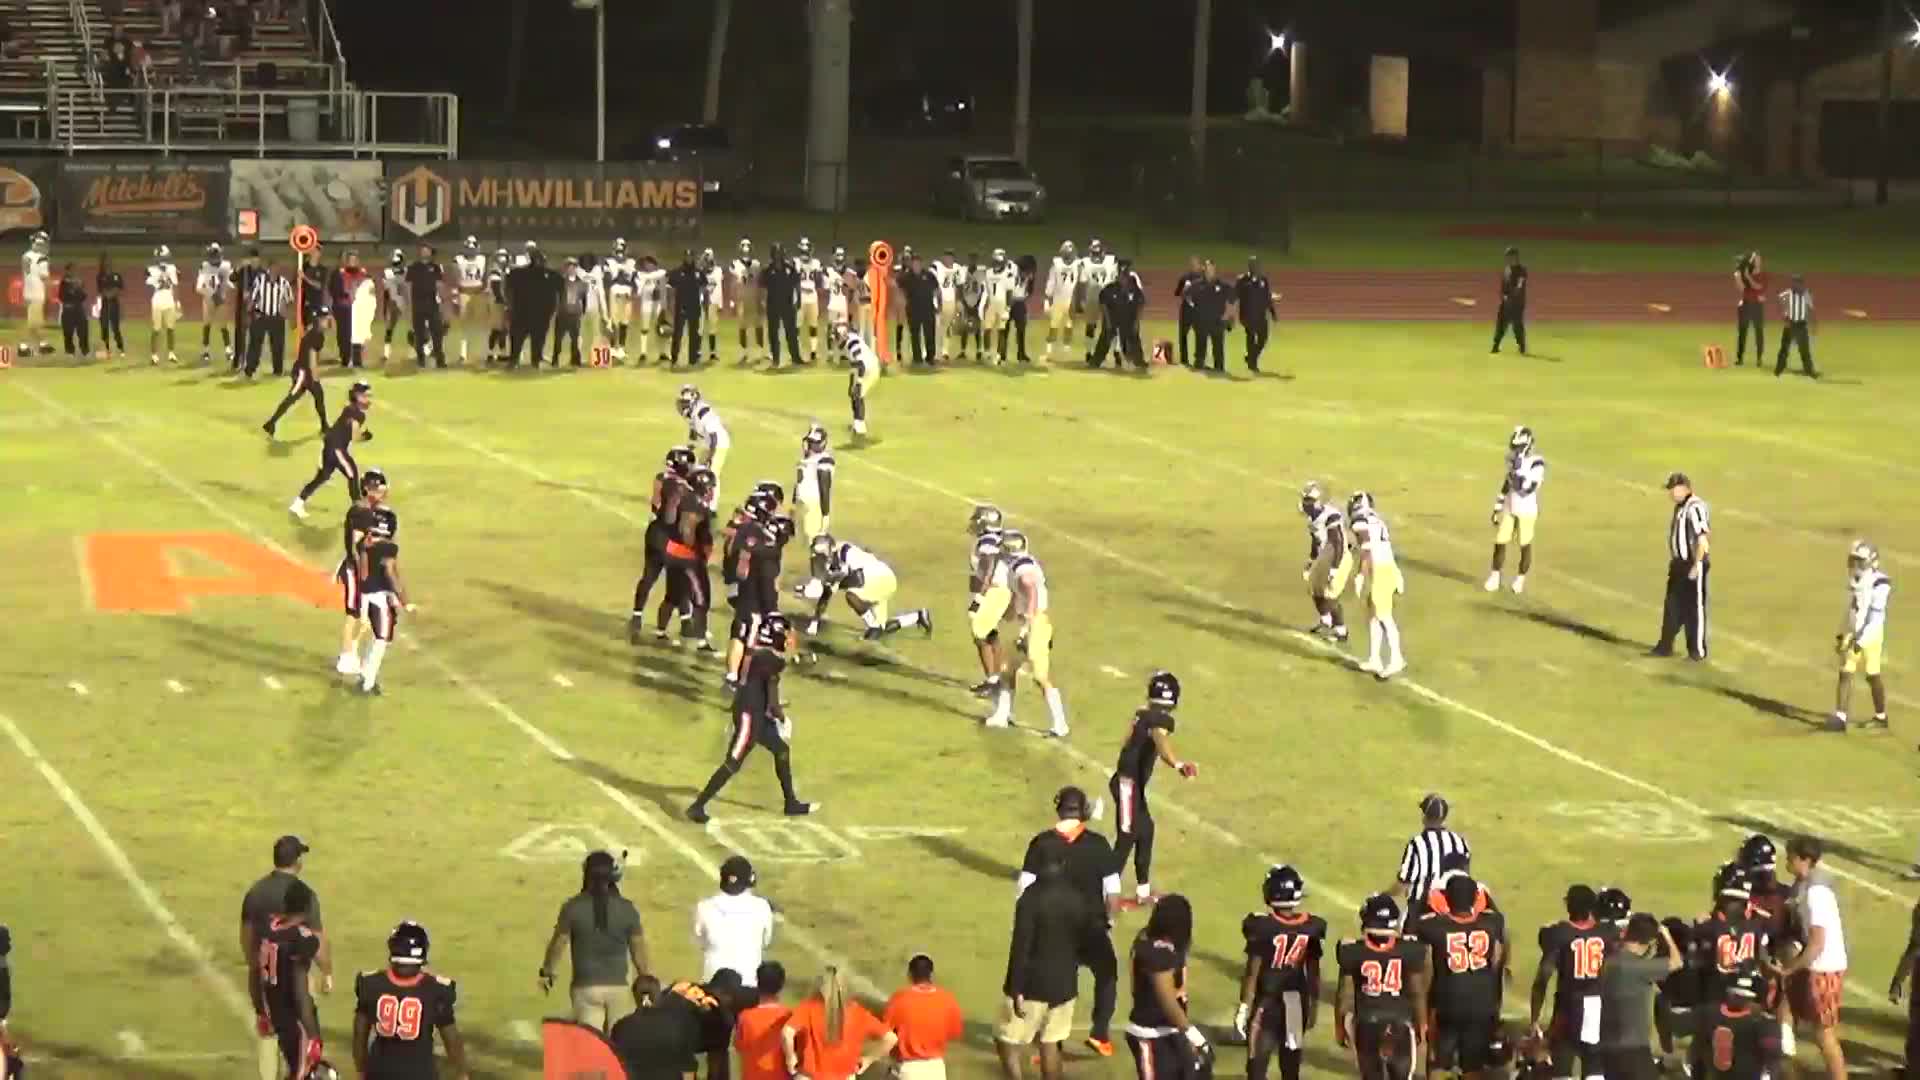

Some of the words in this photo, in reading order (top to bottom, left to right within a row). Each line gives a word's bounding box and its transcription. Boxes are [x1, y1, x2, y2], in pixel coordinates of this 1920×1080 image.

[1272, 934, 1309, 969] 14
[1446, 930, 1490, 973] 52
[1361, 959, 1402, 997] 34
[376, 994, 423, 1040] 99
